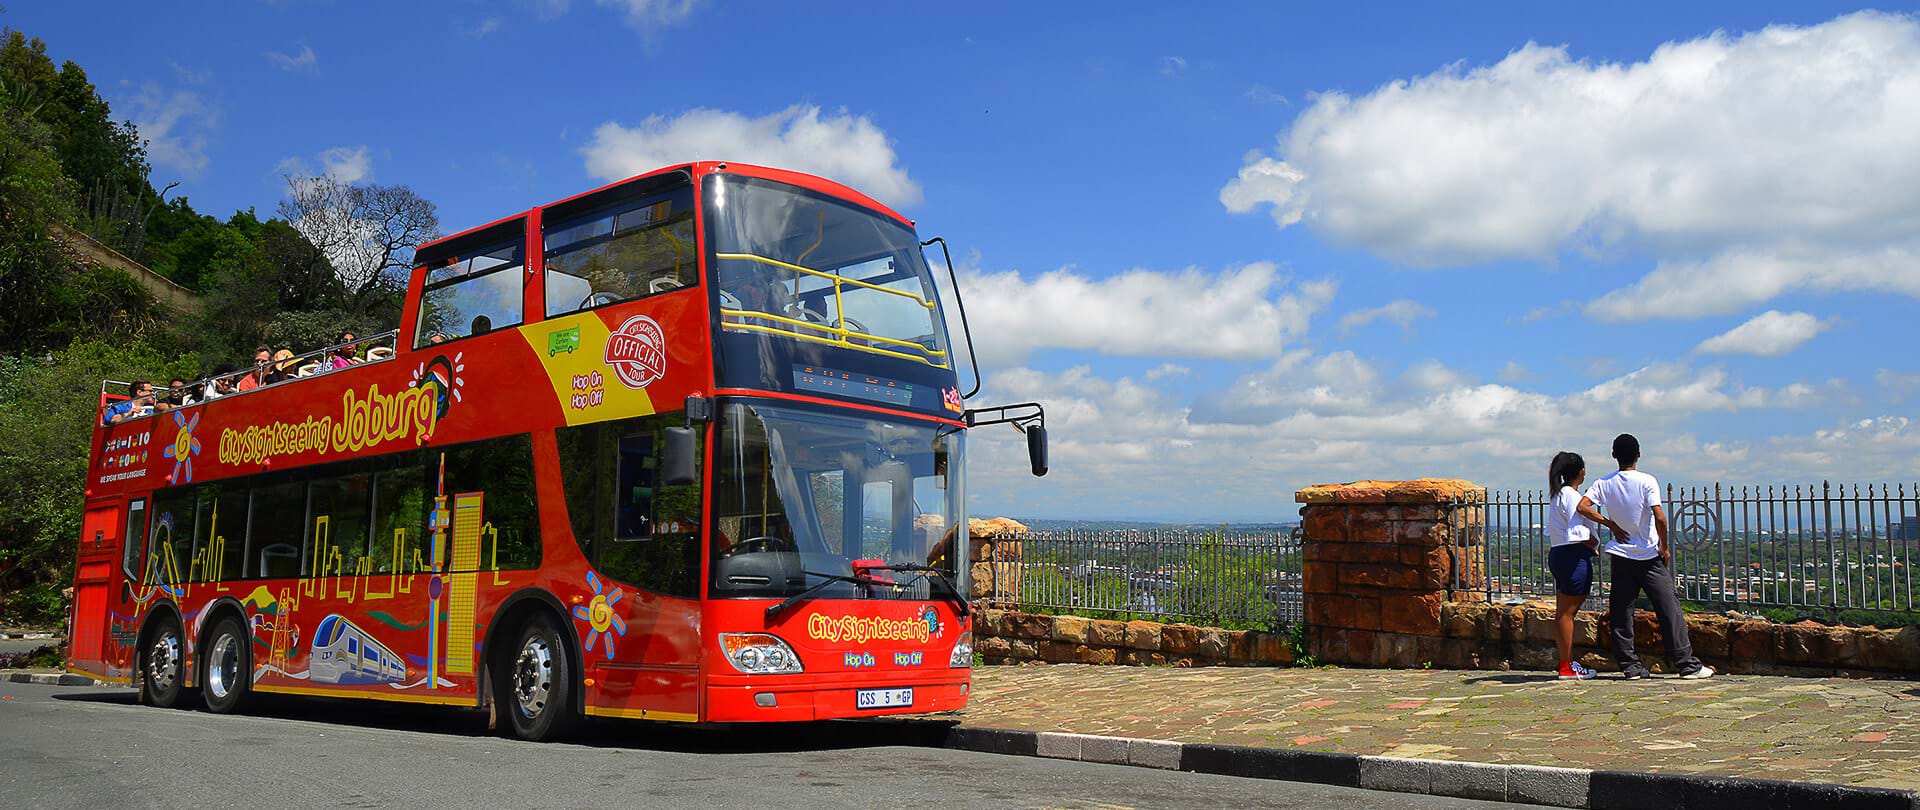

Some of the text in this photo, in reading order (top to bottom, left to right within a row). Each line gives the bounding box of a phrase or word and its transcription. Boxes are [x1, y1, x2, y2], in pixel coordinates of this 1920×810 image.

[613, 337, 660, 370] OFFICIAL
[572, 370, 603, 390] Hop On
[628, 368, 646, 381] TOUR
[571, 390, 604, 410] Hop Off
[332, 381, 439, 447] Joburg
[844, 652, 875, 668] Hop On
[894, 651, 924, 667] Hop Off
[860, 690, 911, 706] CSS 5 GP
